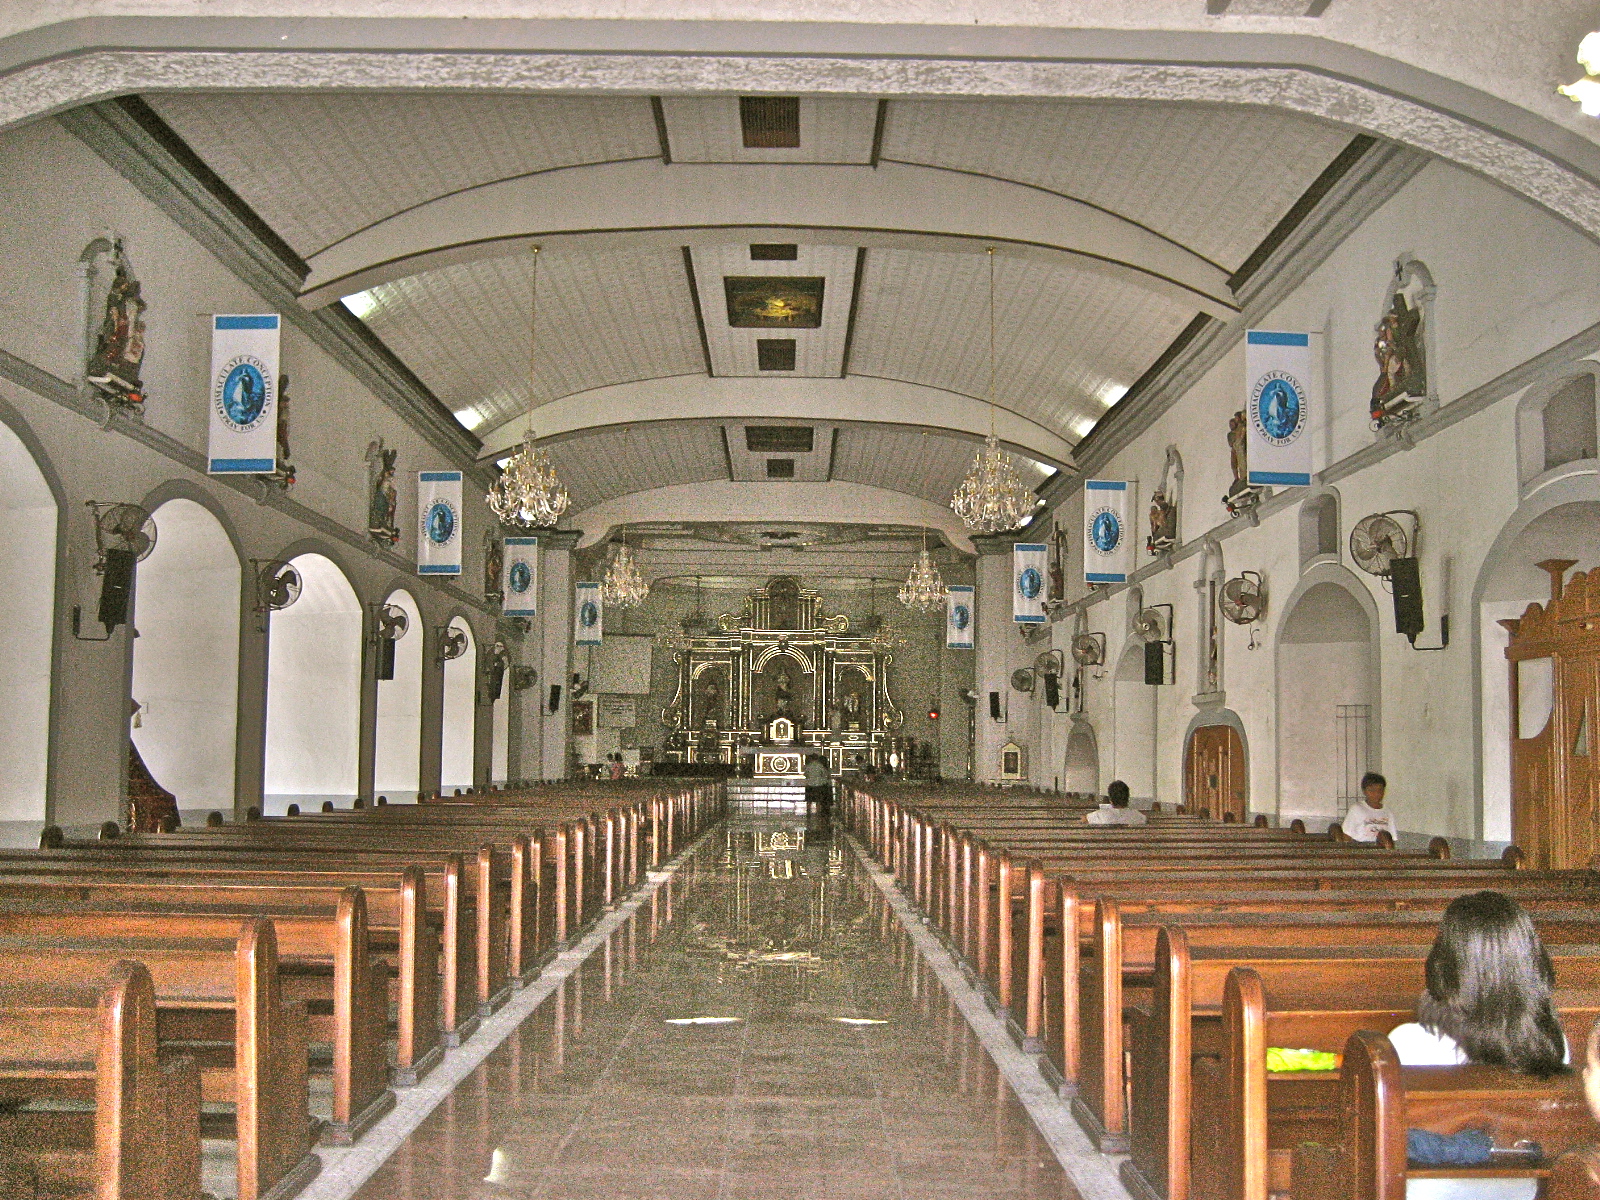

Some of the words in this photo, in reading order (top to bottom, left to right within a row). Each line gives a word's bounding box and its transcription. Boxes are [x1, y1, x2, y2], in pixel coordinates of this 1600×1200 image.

[247, 357, 272, 407] CONCEPTION
[1252, 371, 1279, 423] IMMACULATE
[1280, 372, 1307, 423] CONCEPTION
[1259, 428, 1274, 443] PRAY
[1277, 437, 1291, 445] FOR
